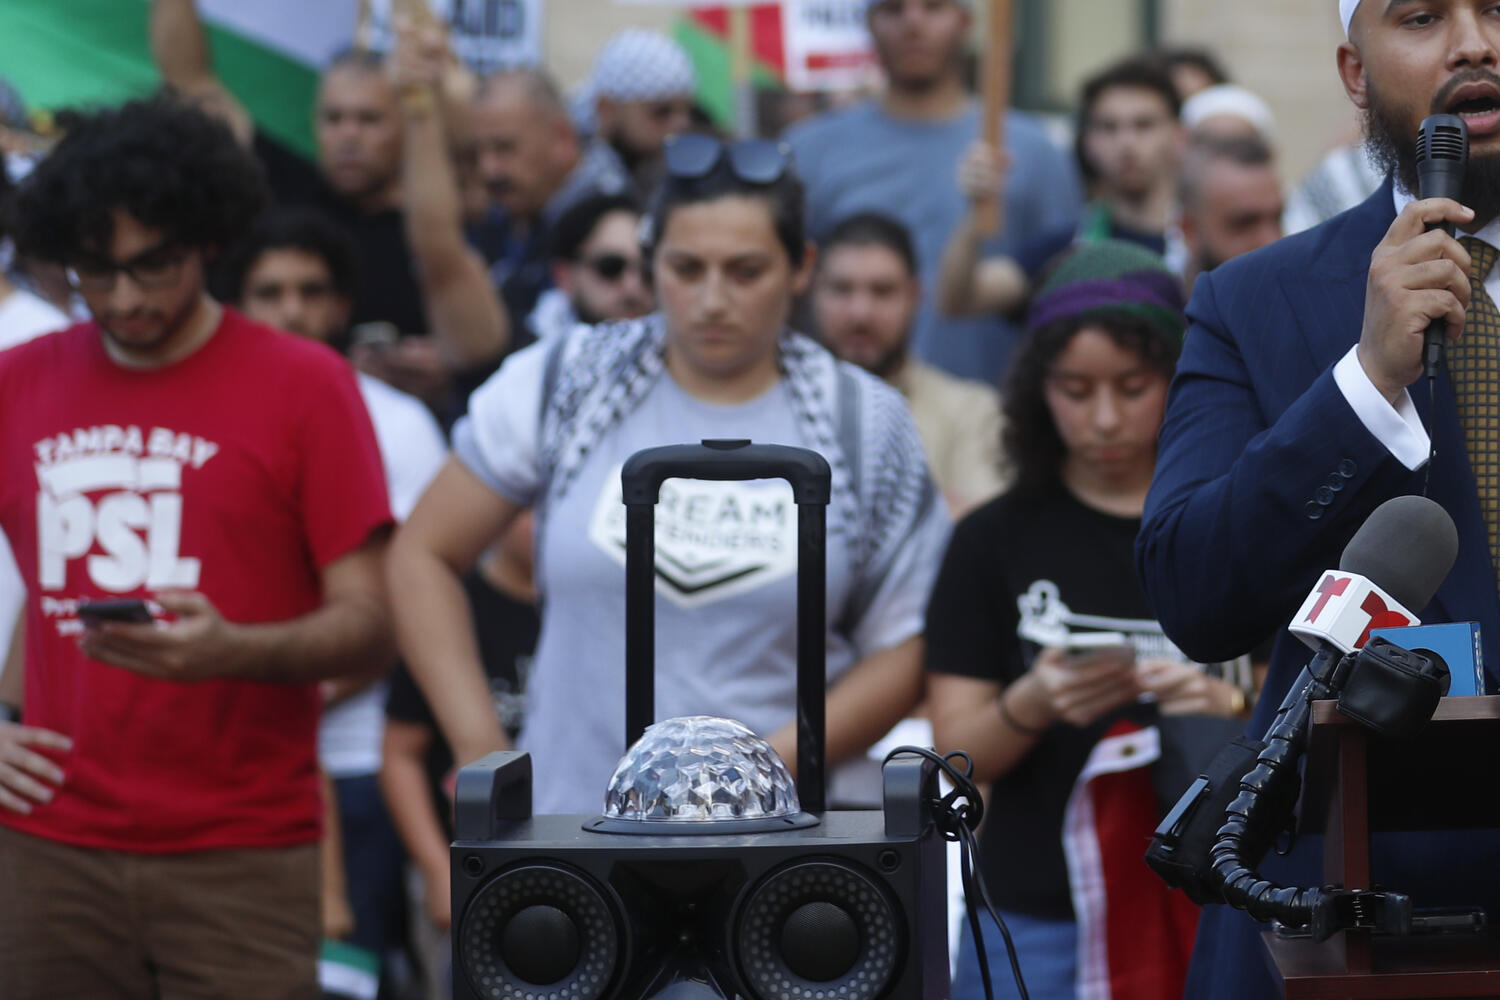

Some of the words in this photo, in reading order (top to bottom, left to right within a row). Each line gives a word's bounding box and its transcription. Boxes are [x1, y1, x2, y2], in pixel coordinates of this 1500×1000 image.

[34, 424, 144, 466] TAMPA
[148, 426, 219, 470] BAY
[36, 489, 202, 593] PSL
